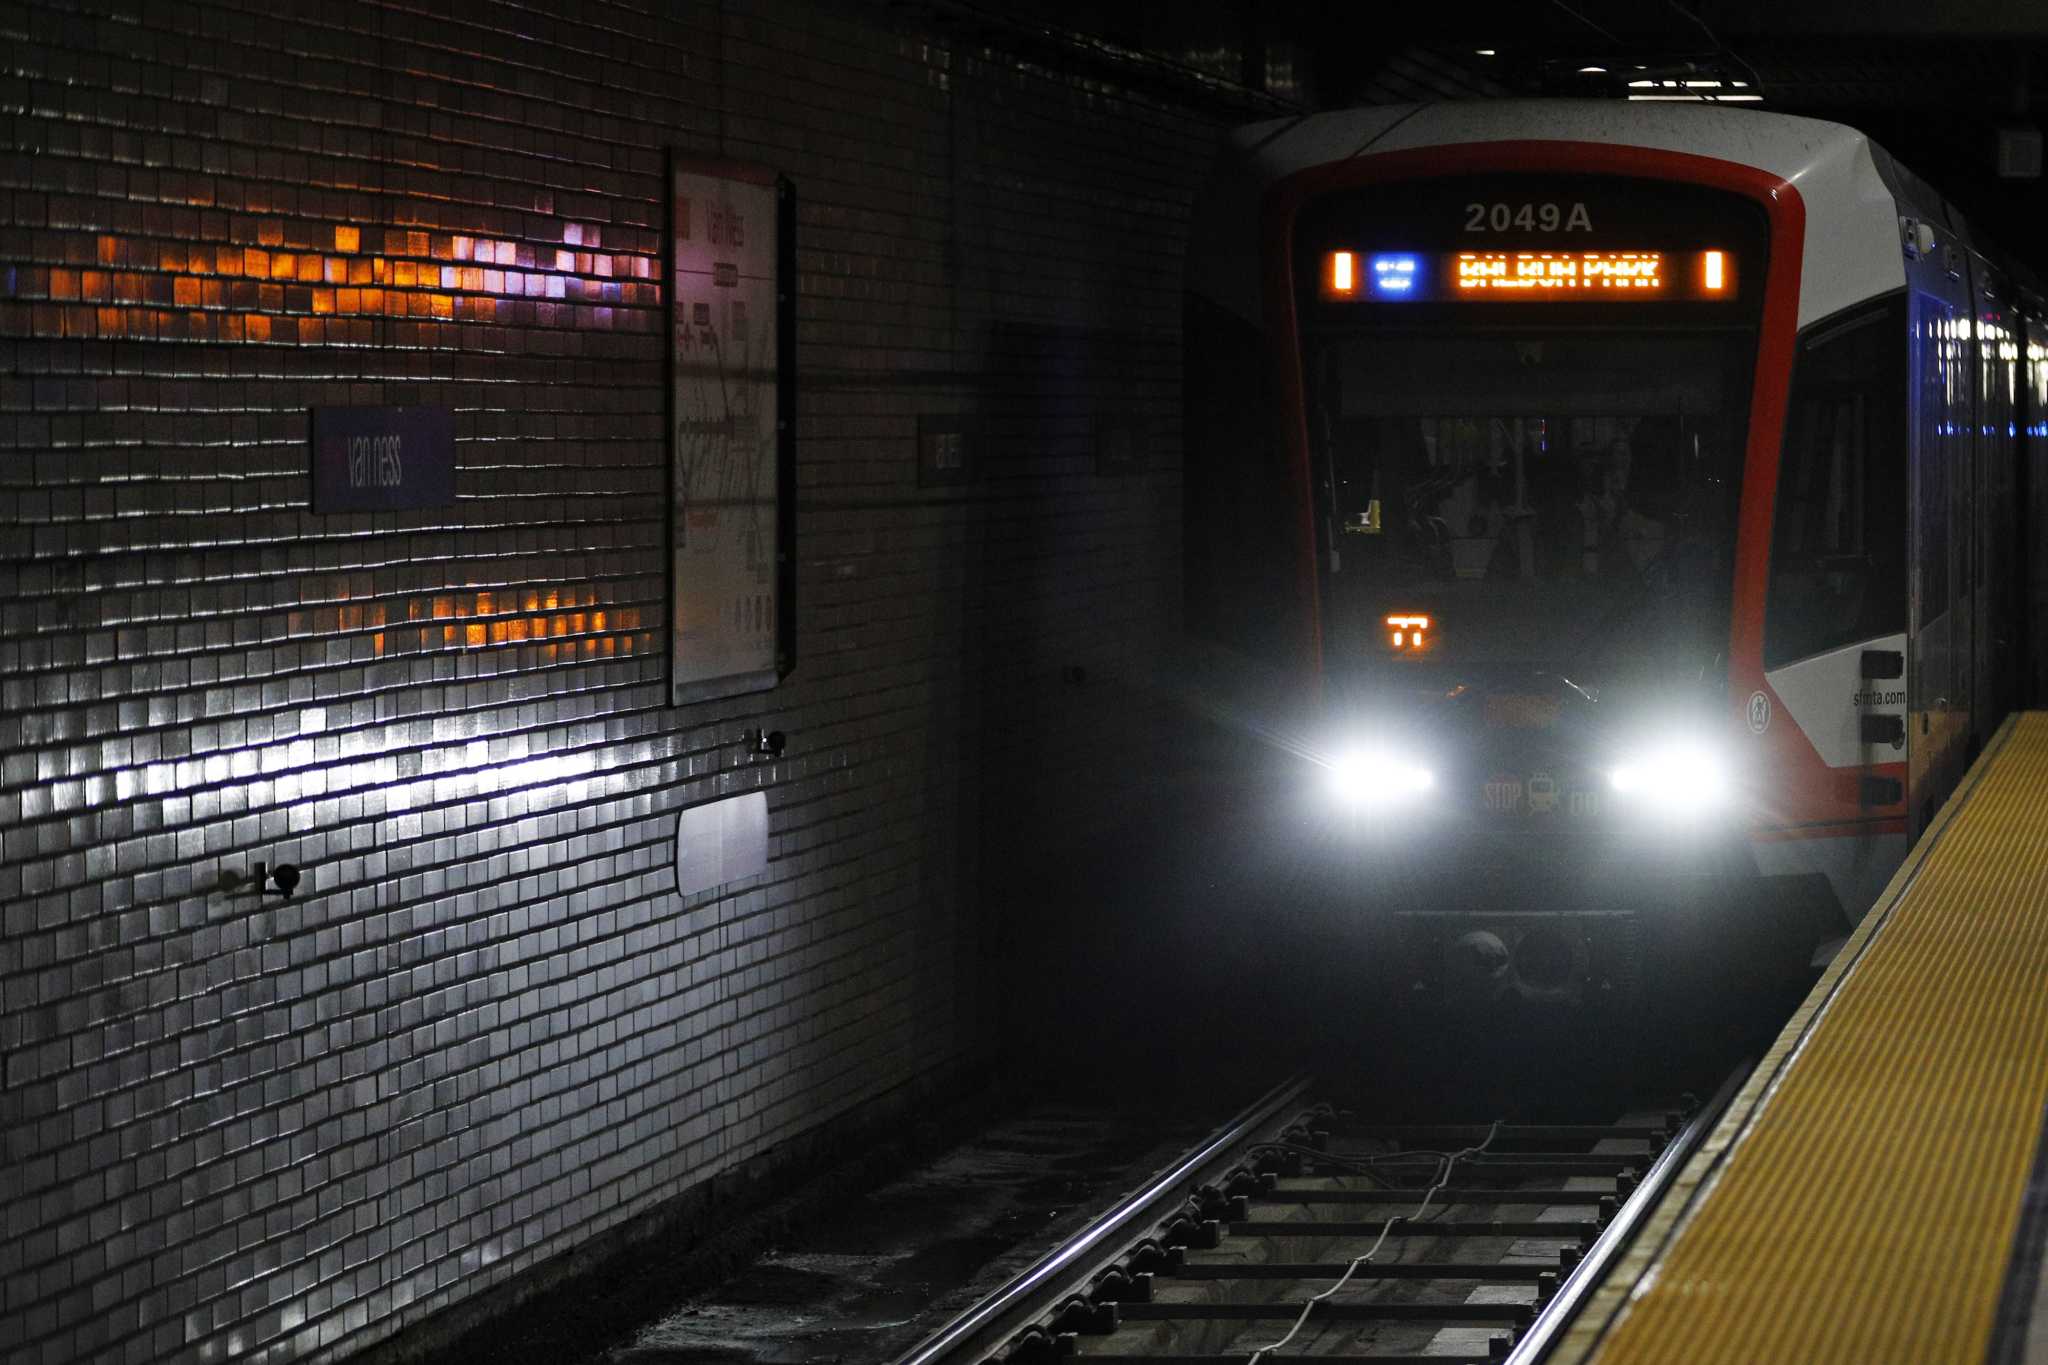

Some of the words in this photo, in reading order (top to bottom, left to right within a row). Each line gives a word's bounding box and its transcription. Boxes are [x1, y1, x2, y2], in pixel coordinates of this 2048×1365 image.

[1463, 202, 1593, 232] 2049A
[1459, 254, 1577, 288] BALBOA
[1582, 254, 1661, 288] PARK
[347, 435, 371, 488] van
[373, 434, 403, 487] ness
[1852, 689, 1907, 708] sfmta.com
